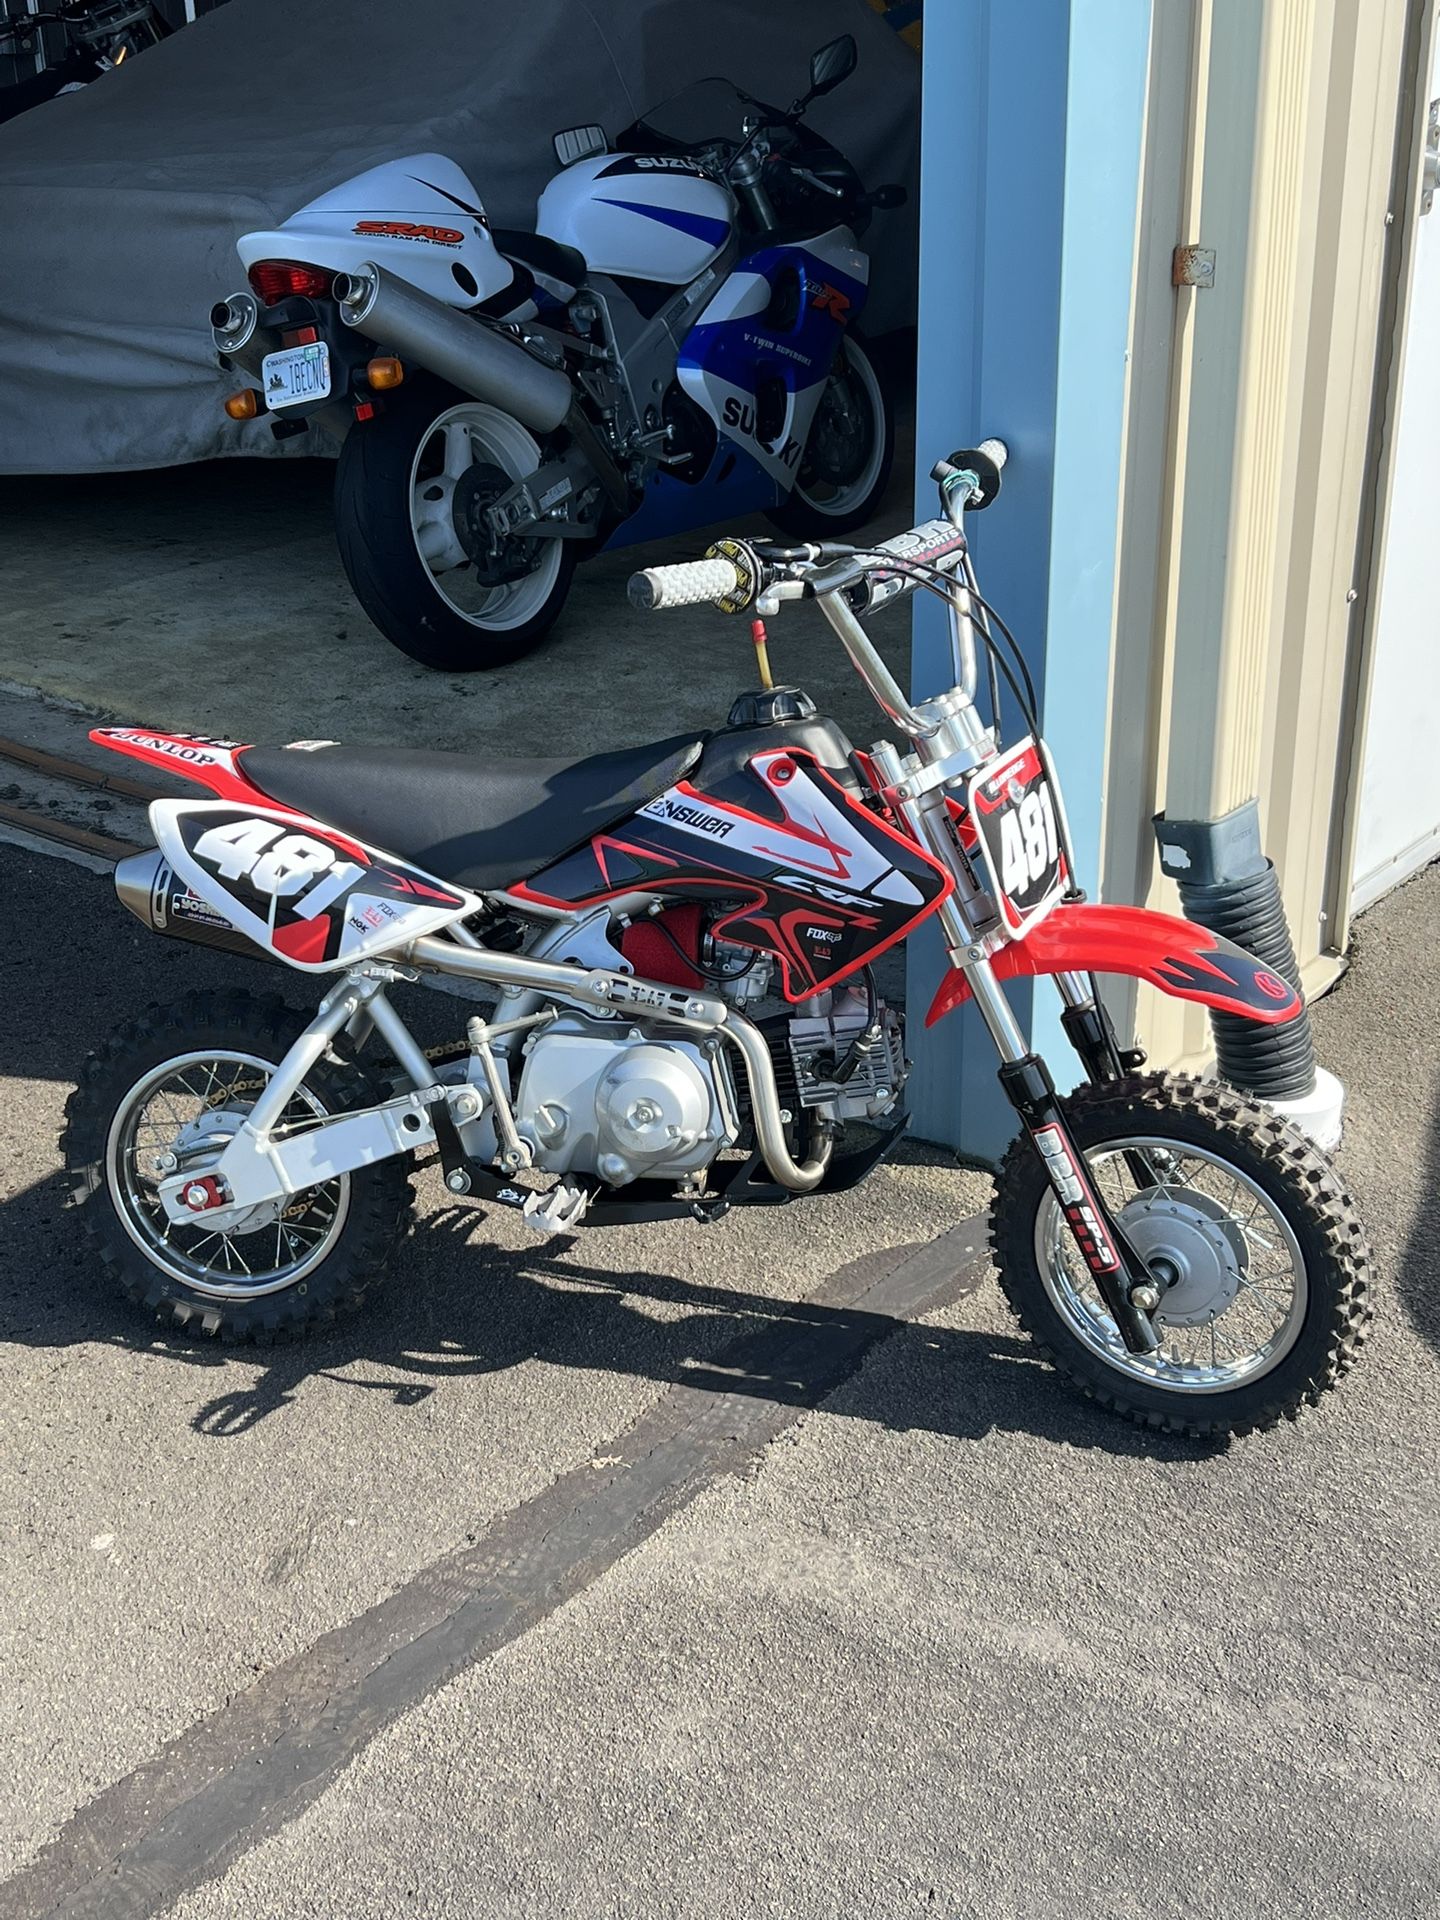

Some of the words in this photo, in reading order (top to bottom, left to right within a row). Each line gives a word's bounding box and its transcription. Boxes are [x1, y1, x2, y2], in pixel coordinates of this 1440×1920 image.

[353, 221, 465, 243] SRAD
[391, 234, 412, 242] RAM
[723, 397, 802, 468] SUKI
[1001, 780, 1058, 896] 481
[193, 818, 367, 921] 481
[773, 876, 884, 908] CRF
[349, 917, 370, 933] NGK
[806, 927, 828, 941] FOX
[1034, 1128, 1084, 1205] BBR
